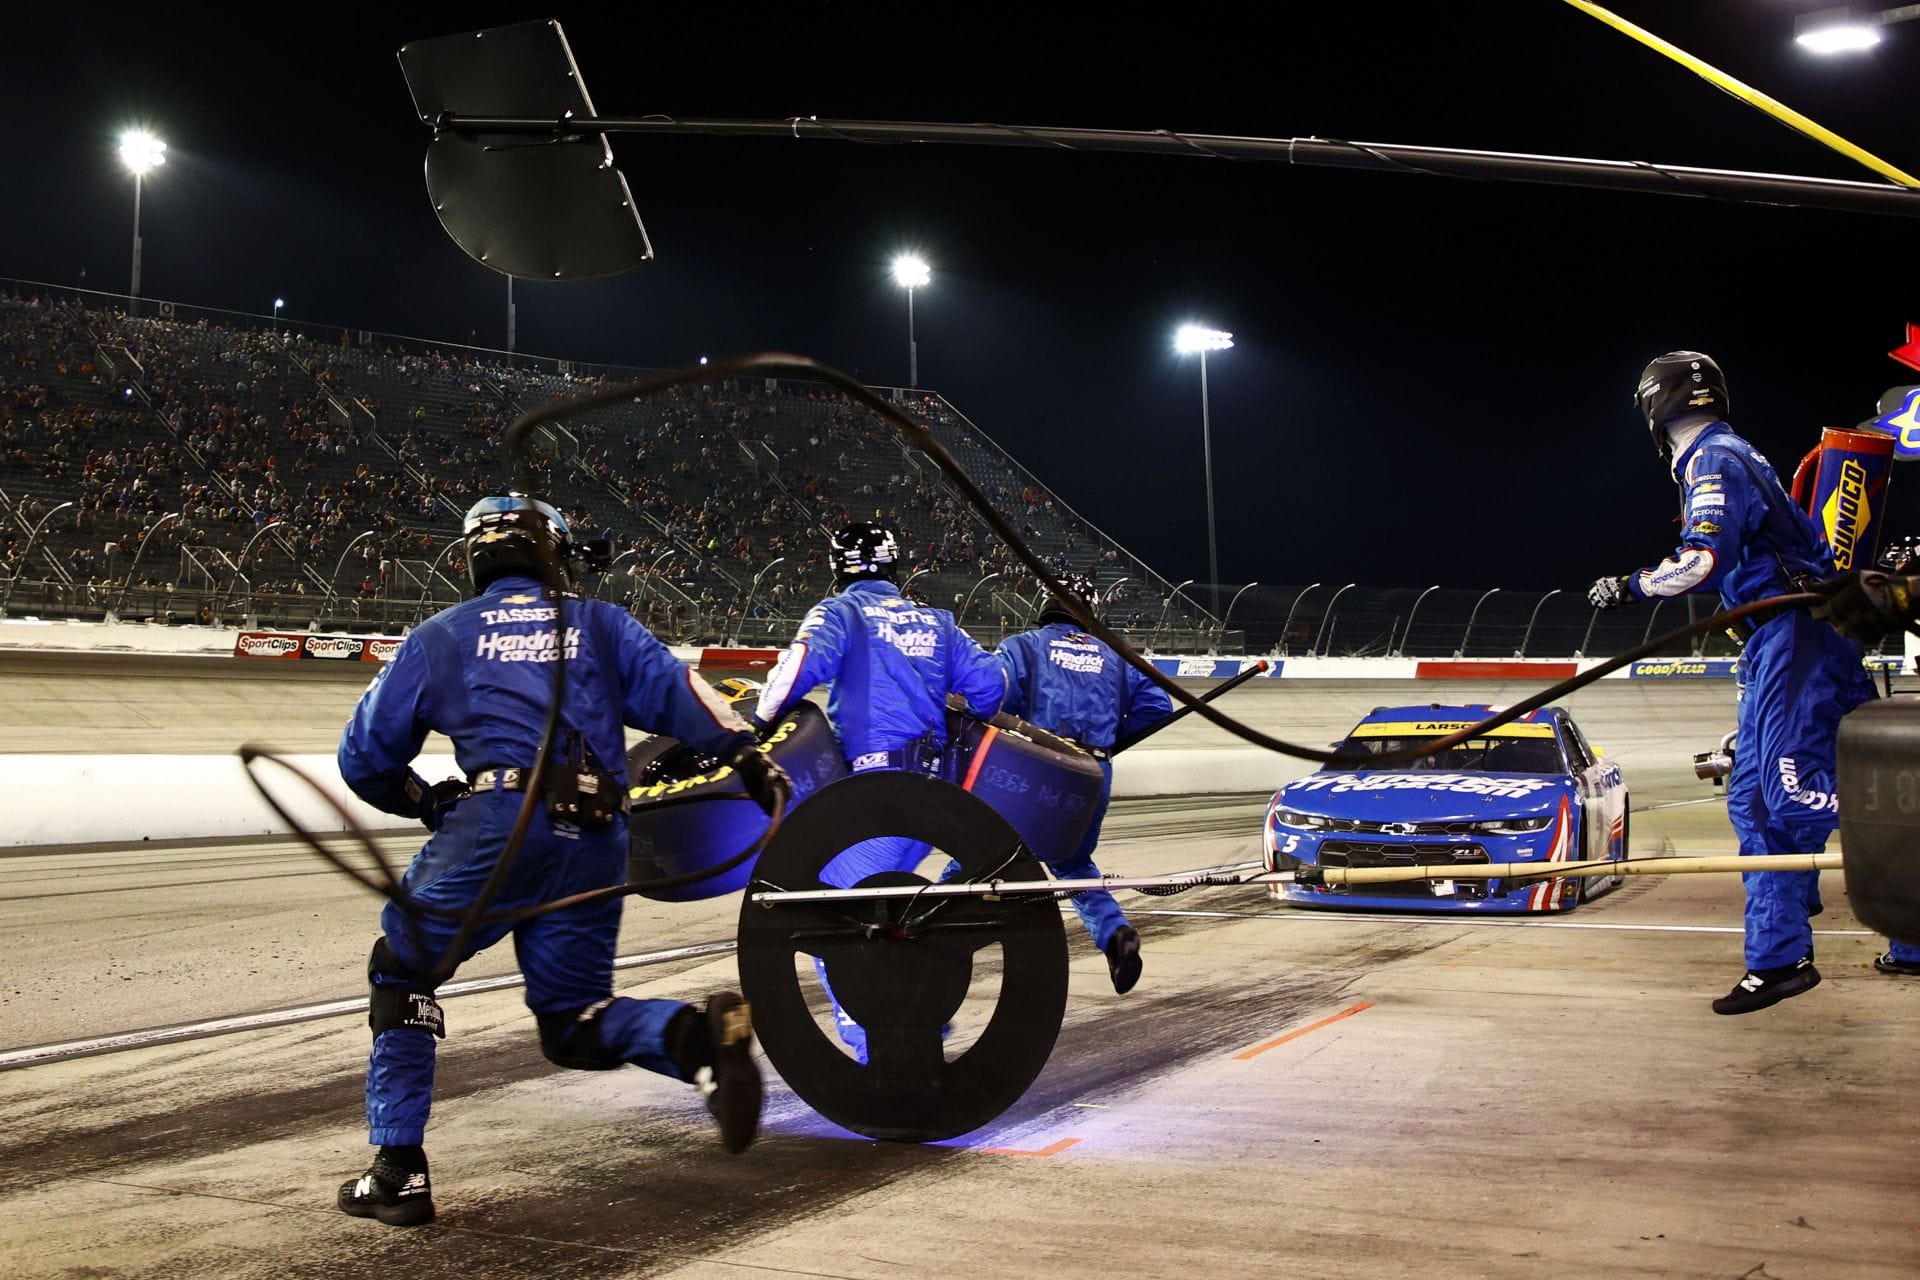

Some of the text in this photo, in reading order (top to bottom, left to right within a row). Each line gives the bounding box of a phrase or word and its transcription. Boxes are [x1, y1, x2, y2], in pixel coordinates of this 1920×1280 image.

[1832, 464, 1865, 567] SUNOCO
[240, 637, 298, 650] SportClips
[306, 639, 362, 652] SportClips
[1050, 649, 1105, 667] Hendrick
[1636, 661, 1707, 677] GOODYEAR
[1282, 835, 1299, 853] 5
